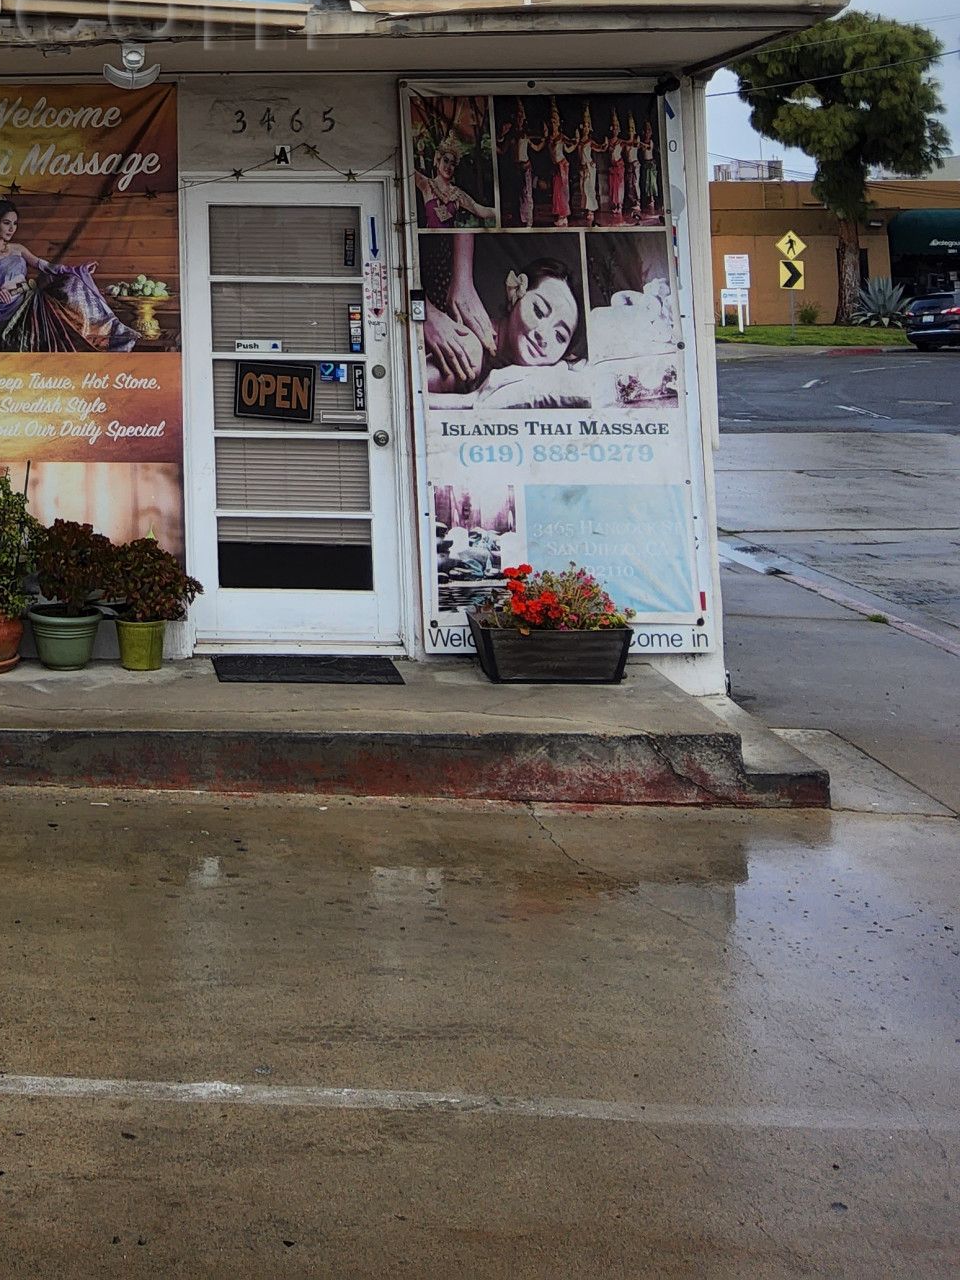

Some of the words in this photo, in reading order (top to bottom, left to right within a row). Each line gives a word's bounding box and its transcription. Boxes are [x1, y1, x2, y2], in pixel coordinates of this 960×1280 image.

[19, 143, 161, 192] Massage
[276, 146, 290, 164] A
[236, 342, 260, 350] Push
[81, 373, 109, 390] Hot
[241, 371, 311, 410] OPEN
[355, 368, 365, 408] PUSH
[0, 396, 62, 414] Swedish
[64, 396, 108, 421] Style
[24, 420, 56, 438] Our
[58, 420, 102, 446] Daily
[105, 420, 167, 442] Special
[458, 441, 525, 468] (619)
[533, 443, 655, 463] 888-0279
[692, 628, 709, 648] in
